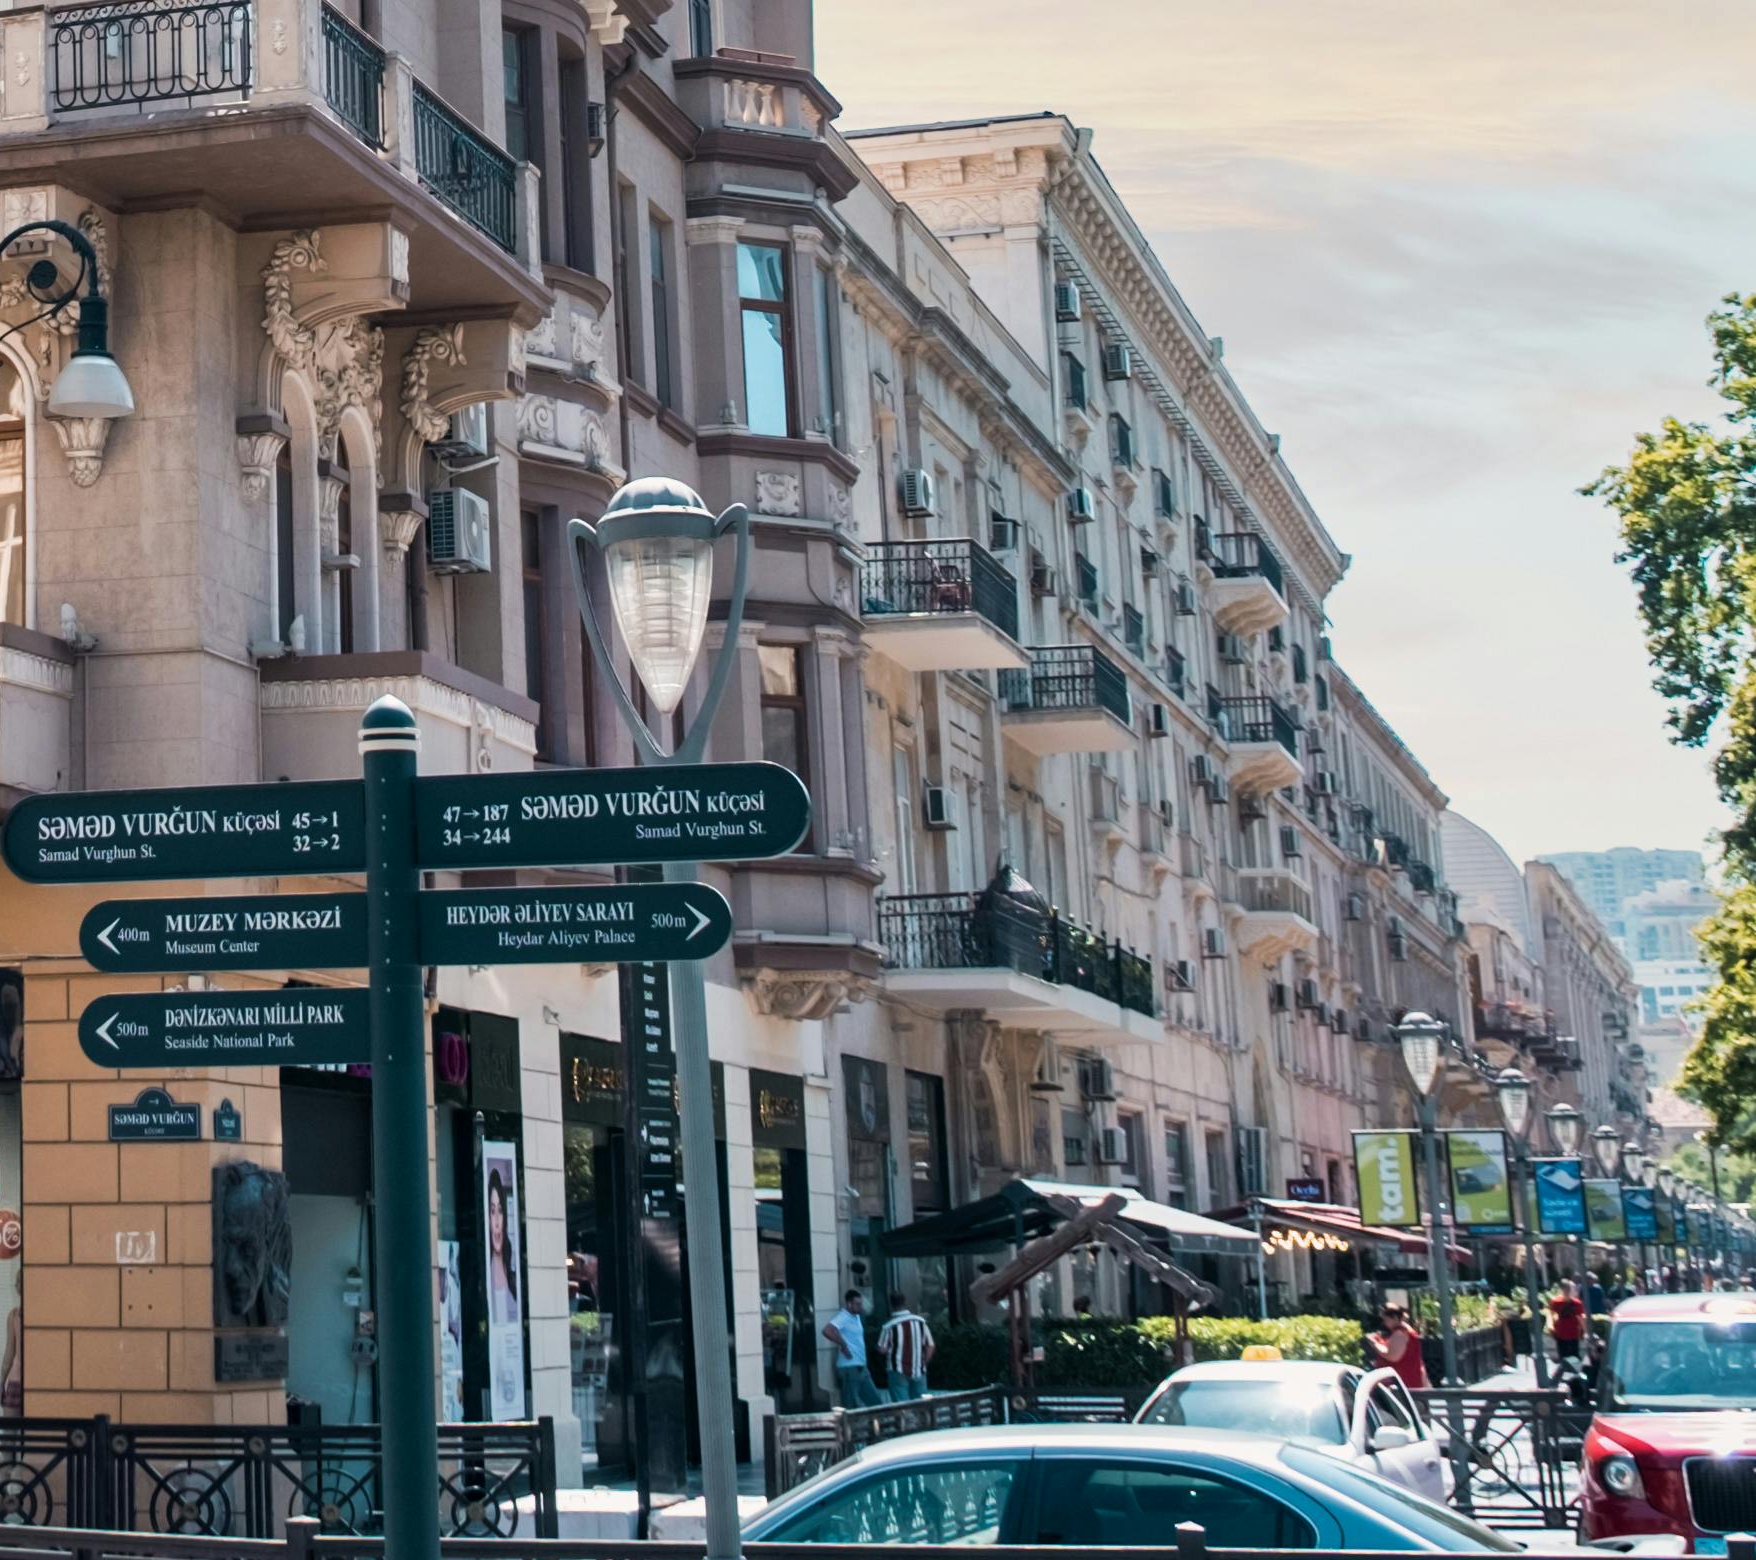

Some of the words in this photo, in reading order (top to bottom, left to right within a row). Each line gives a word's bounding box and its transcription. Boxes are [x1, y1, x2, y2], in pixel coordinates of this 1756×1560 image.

[521, 794, 599, 821] SƏMƏD
[604, 785, 700, 817] VURĞUN
[706, 789, 765, 816] KÜÇƏSİ
[38, 815, 115, 841] SƏMƏD
[122, 805, 217, 836] VURĞUN
[223, 810, 280, 835] KÜÇƏSİ
[292, 812, 310, 830] 45
[332, 811, 338, 827] 1
[443, 806, 461, 823] 47
[483, 804, 509, 822] 187
[443, 828, 461, 846] 34
[483, 827, 511, 845] 244
[635, 823, 681, 840] Samad
[685, 821, 744, 840] Vurghun
[749, 819, 767, 835] St.
[292, 835, 310, 852] 32
[331, 834, 340, 850] 2
[39, 847, 79, 862] Samad
[83, 846, 136, 863] Vurghun
[141, 844, 156, 858] St.
[165, 912, 239, 933] MUZEY
[244, 905, 342, 931] MƏRKƏZİ
[446, 905, 511, 926] HEYDƏR
[515, 900, 573, 922] ƏLİYEV
[576, 901, 634, 922] SARAYI
[117, 927, 150, 942] 400m
[498, 931, 544, 949] Heydar
[547, 929, 590, 947] Aliyev
[594, 928, 635, 944] Palace
[165, 940, 216, 955] Museum
[219, 939, 260, 953] Center
[164, 1003, 260, 1028] DƏNİZKƏNARI
[263, 1001, 304, 1025] MİLLİ
[307, 1004, 345, 1024] PARK
[164, 1034, 209, 1049] Seaside
[213, 1032, 264, 1048] National
[267, 1032, 295, 1047] Park
[114, 1113, 150, 1125] SƏMƏD
[152, 1110, 195, 1125] VURĞUN
